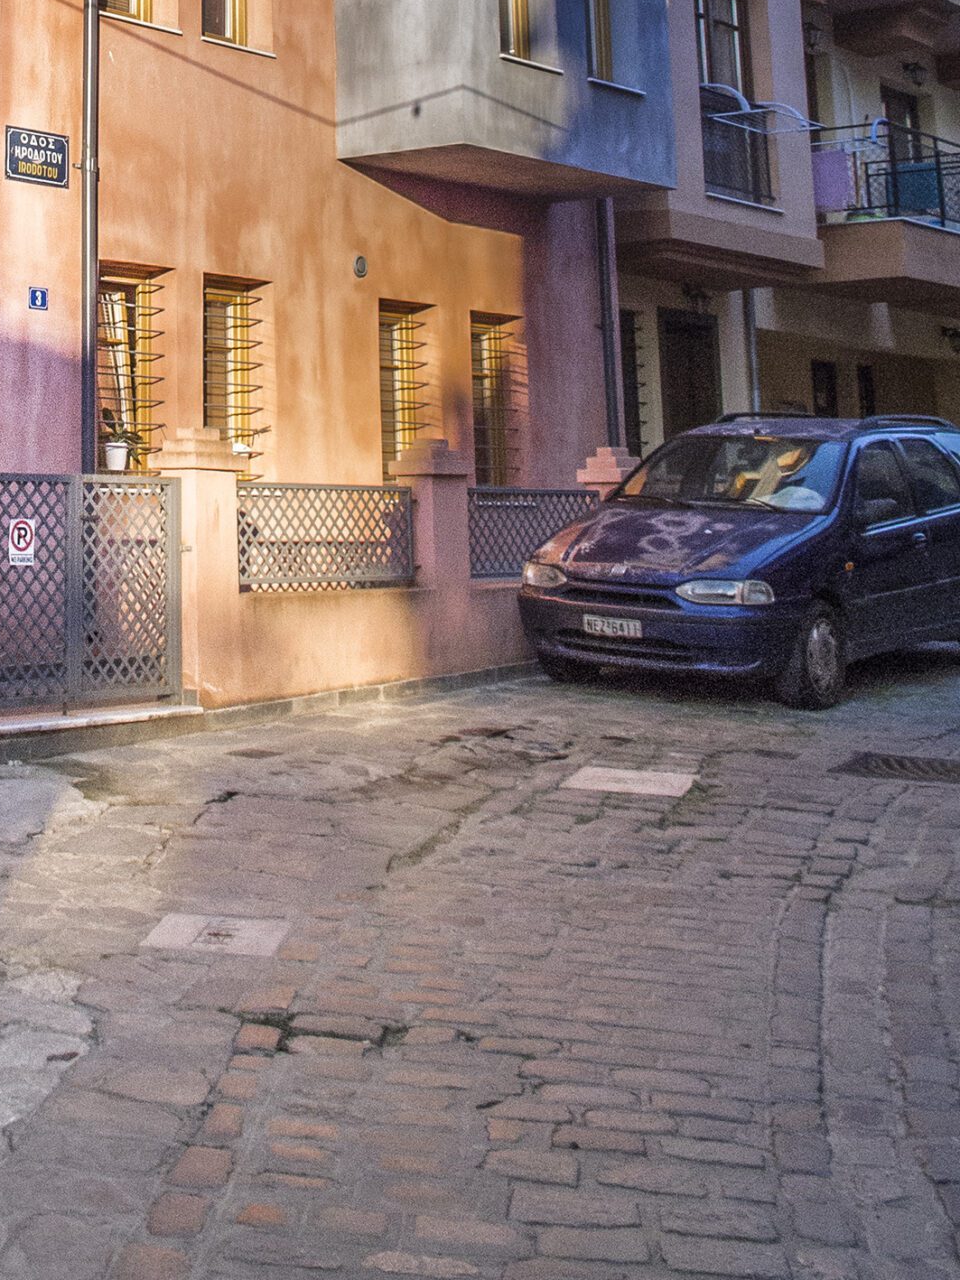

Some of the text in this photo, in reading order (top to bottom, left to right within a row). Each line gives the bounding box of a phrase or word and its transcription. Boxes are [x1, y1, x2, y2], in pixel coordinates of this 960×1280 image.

[20, 133, 55, 149] ΟΔΟΣ
[18, 160, 58, 179] IRODOTOU
[35, 291, 42, 306] 3
